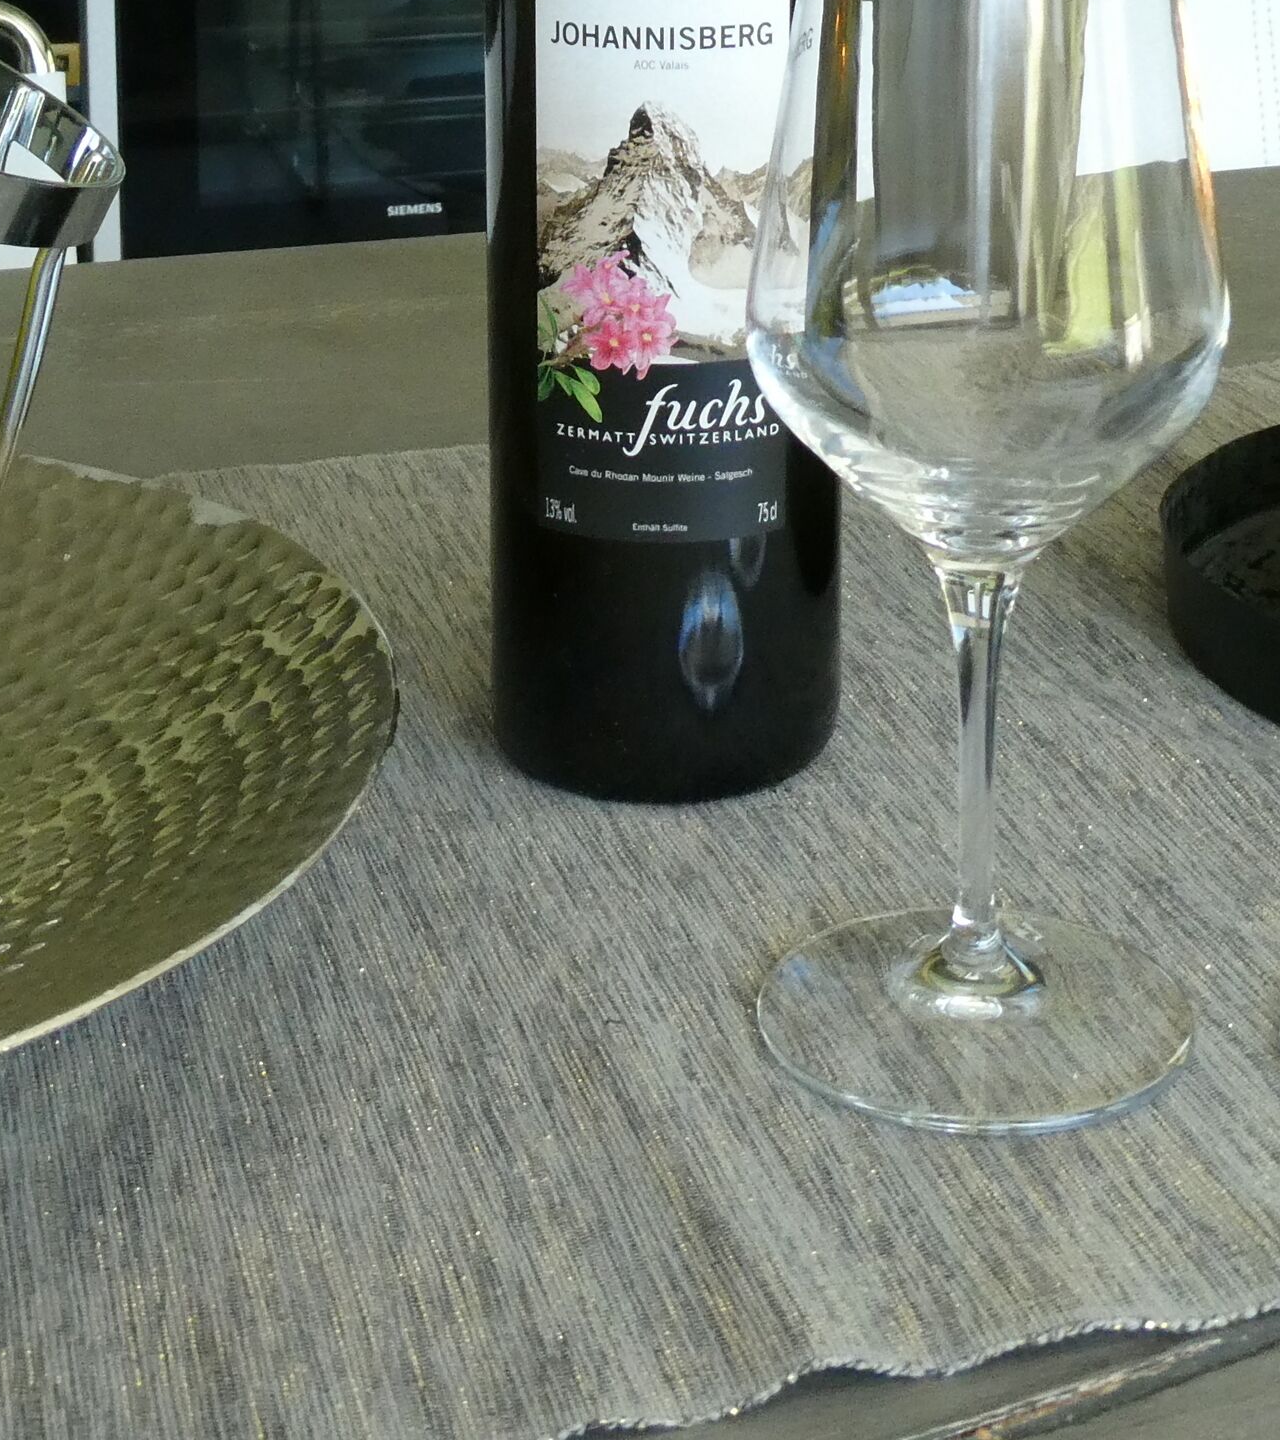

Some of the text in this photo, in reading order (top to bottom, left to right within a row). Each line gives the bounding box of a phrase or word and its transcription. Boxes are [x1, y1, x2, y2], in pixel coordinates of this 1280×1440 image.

[550, 20, 773, 51] JOHANNISBERG
[633, 59, 689, 71] AOC Valais
[386, 202, 442, 217] SIEMENS
[622, 378, 767, 457] fuchs
[556, 422, 780, 445] ZERMATT SWITZERLAND
[590, 468, 603, 478] du
[641, 472, 675, 483] Mounir
[677, 472, 706, 482] Weine
[757, 501, 769, 523] 75
